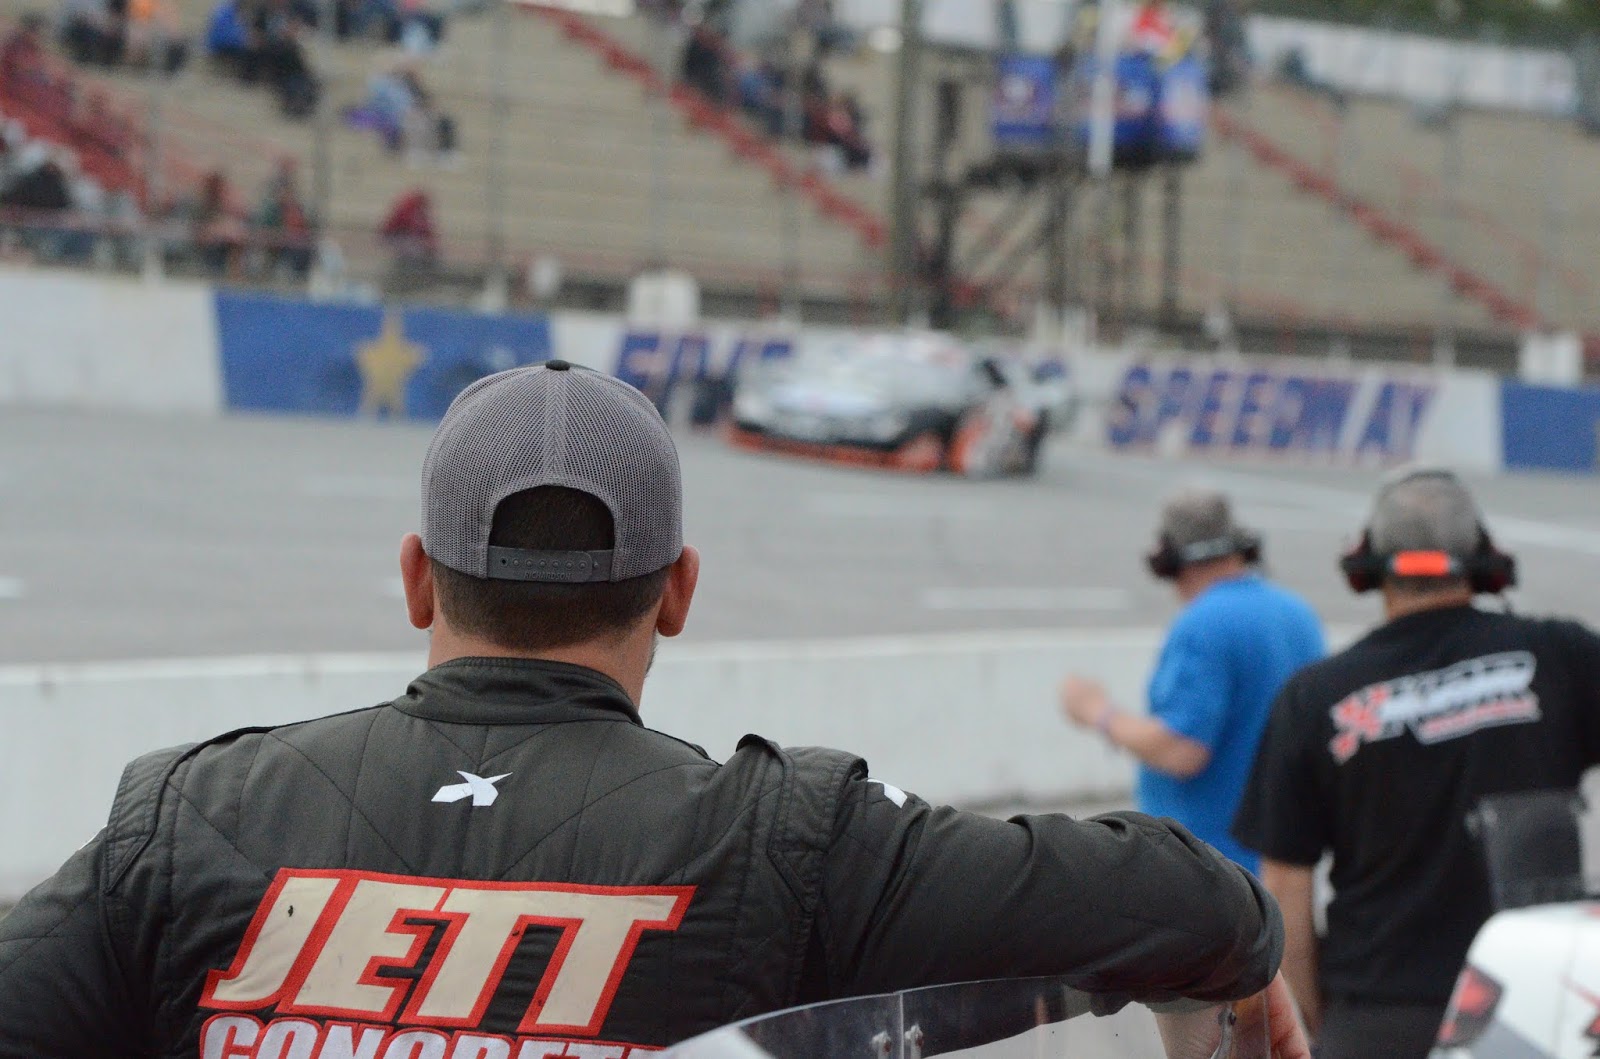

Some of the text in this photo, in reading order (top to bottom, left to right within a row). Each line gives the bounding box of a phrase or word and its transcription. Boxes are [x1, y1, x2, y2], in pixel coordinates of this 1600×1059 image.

[1106, 361, 1437, 458] SPEEDWAY
[523, 569, 572, 581] RICHARDSON
[199, 868, 697, 1036] JETT
